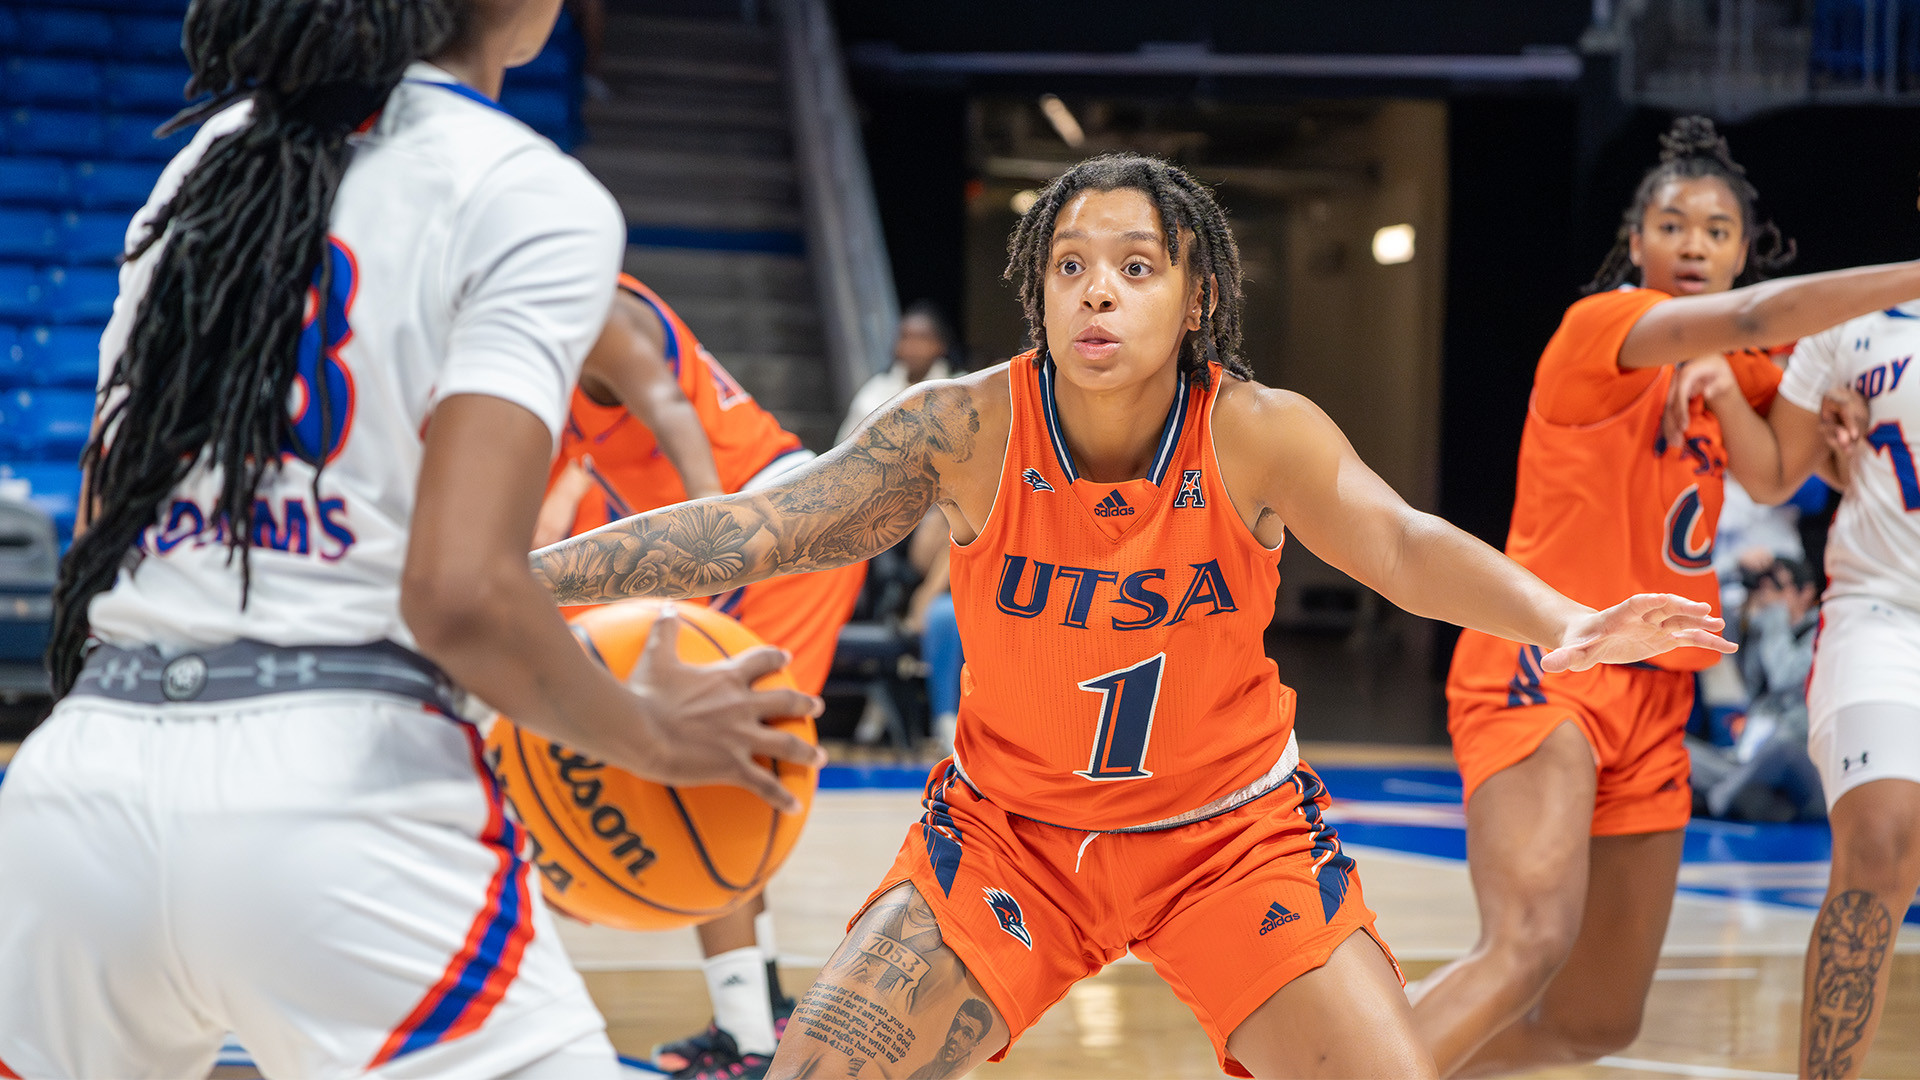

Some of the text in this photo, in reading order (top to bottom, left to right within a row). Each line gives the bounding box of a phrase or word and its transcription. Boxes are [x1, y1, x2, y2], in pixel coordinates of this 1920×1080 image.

[1856, 354, 1912, 399] ADY
[135, 497, 358, 562] DMS
[1094, 504, 1136, 518] adidas
[995, 553, 1239, 631] UTSA
[1072, 651, 1166, 781] 1
[1258, 911, 1301, 937] adidas
[843, 1000, 857, 1010] for
[861, 1010, 876, 1022] am
[875, 1019, 897, 1035] your
[854, 995, 868, 1005] am
[869, 1002, 889, 1018] with
[905, 1028, 917, 1041] Do
[803, 1027, 855, 1057] Isaiah 41:10
[821, 1013, 851, 1031] uphold
[848, 1027, 868, 1041] you
[868, 1037, 887, 1055] with
[886, 1050, 899, 1064] my
[832, 1028, 855, 1045] right
[854, 1040, 878, 1059] hand
[876, 1030, 892, 1045] will
[890, 1041, 907, 1059] help
